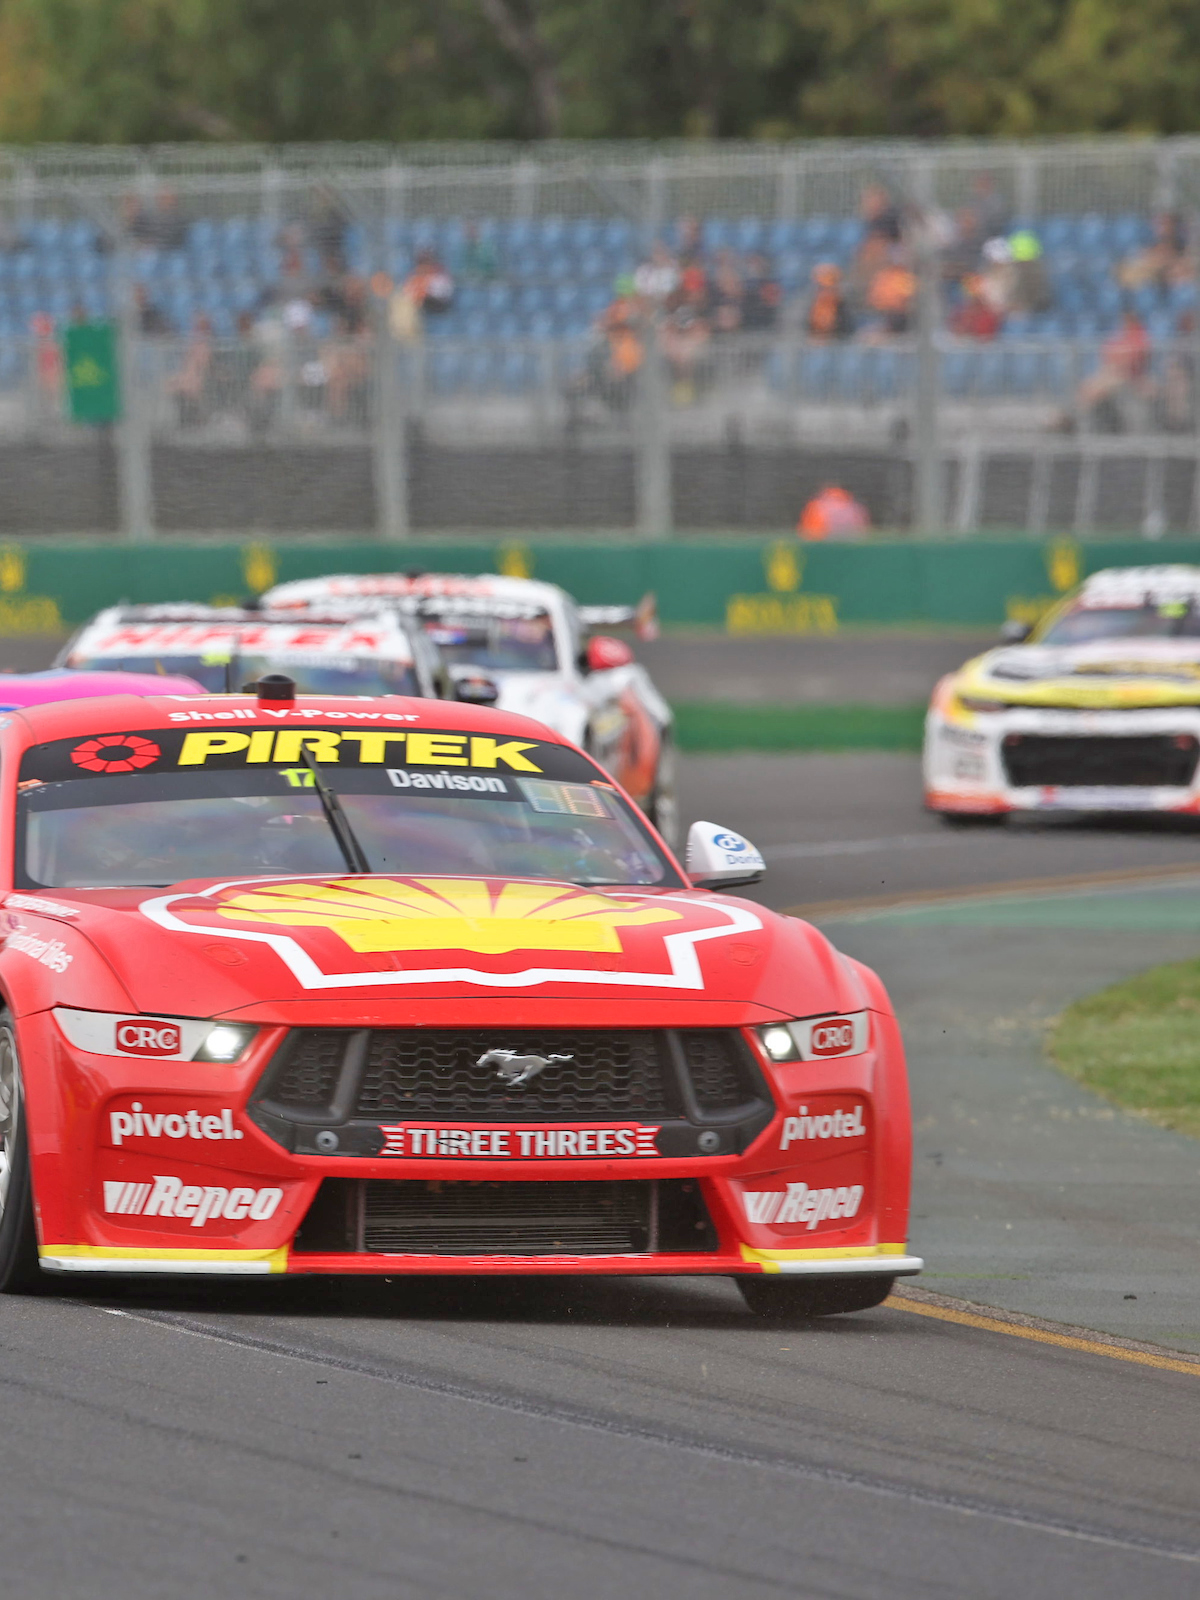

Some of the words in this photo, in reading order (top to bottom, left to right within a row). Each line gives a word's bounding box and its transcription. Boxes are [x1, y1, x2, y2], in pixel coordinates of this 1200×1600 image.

[168, 708, 257, 722] Shell
[263, 708, 420, 722] V-Power
[178, 730, 544, 774] PIRTEK
[278, 768, 316, 788] 17
[387, 768, 508, 793] Davison
[117, 1026, 179, 1050] CRC
[406, 1128, 512, 1157] THREE
[517, 1128, 638, 1156] THREES
[142, 1175, 284, 1228] Repco
[778, 1182, 865, 1231] Repco
